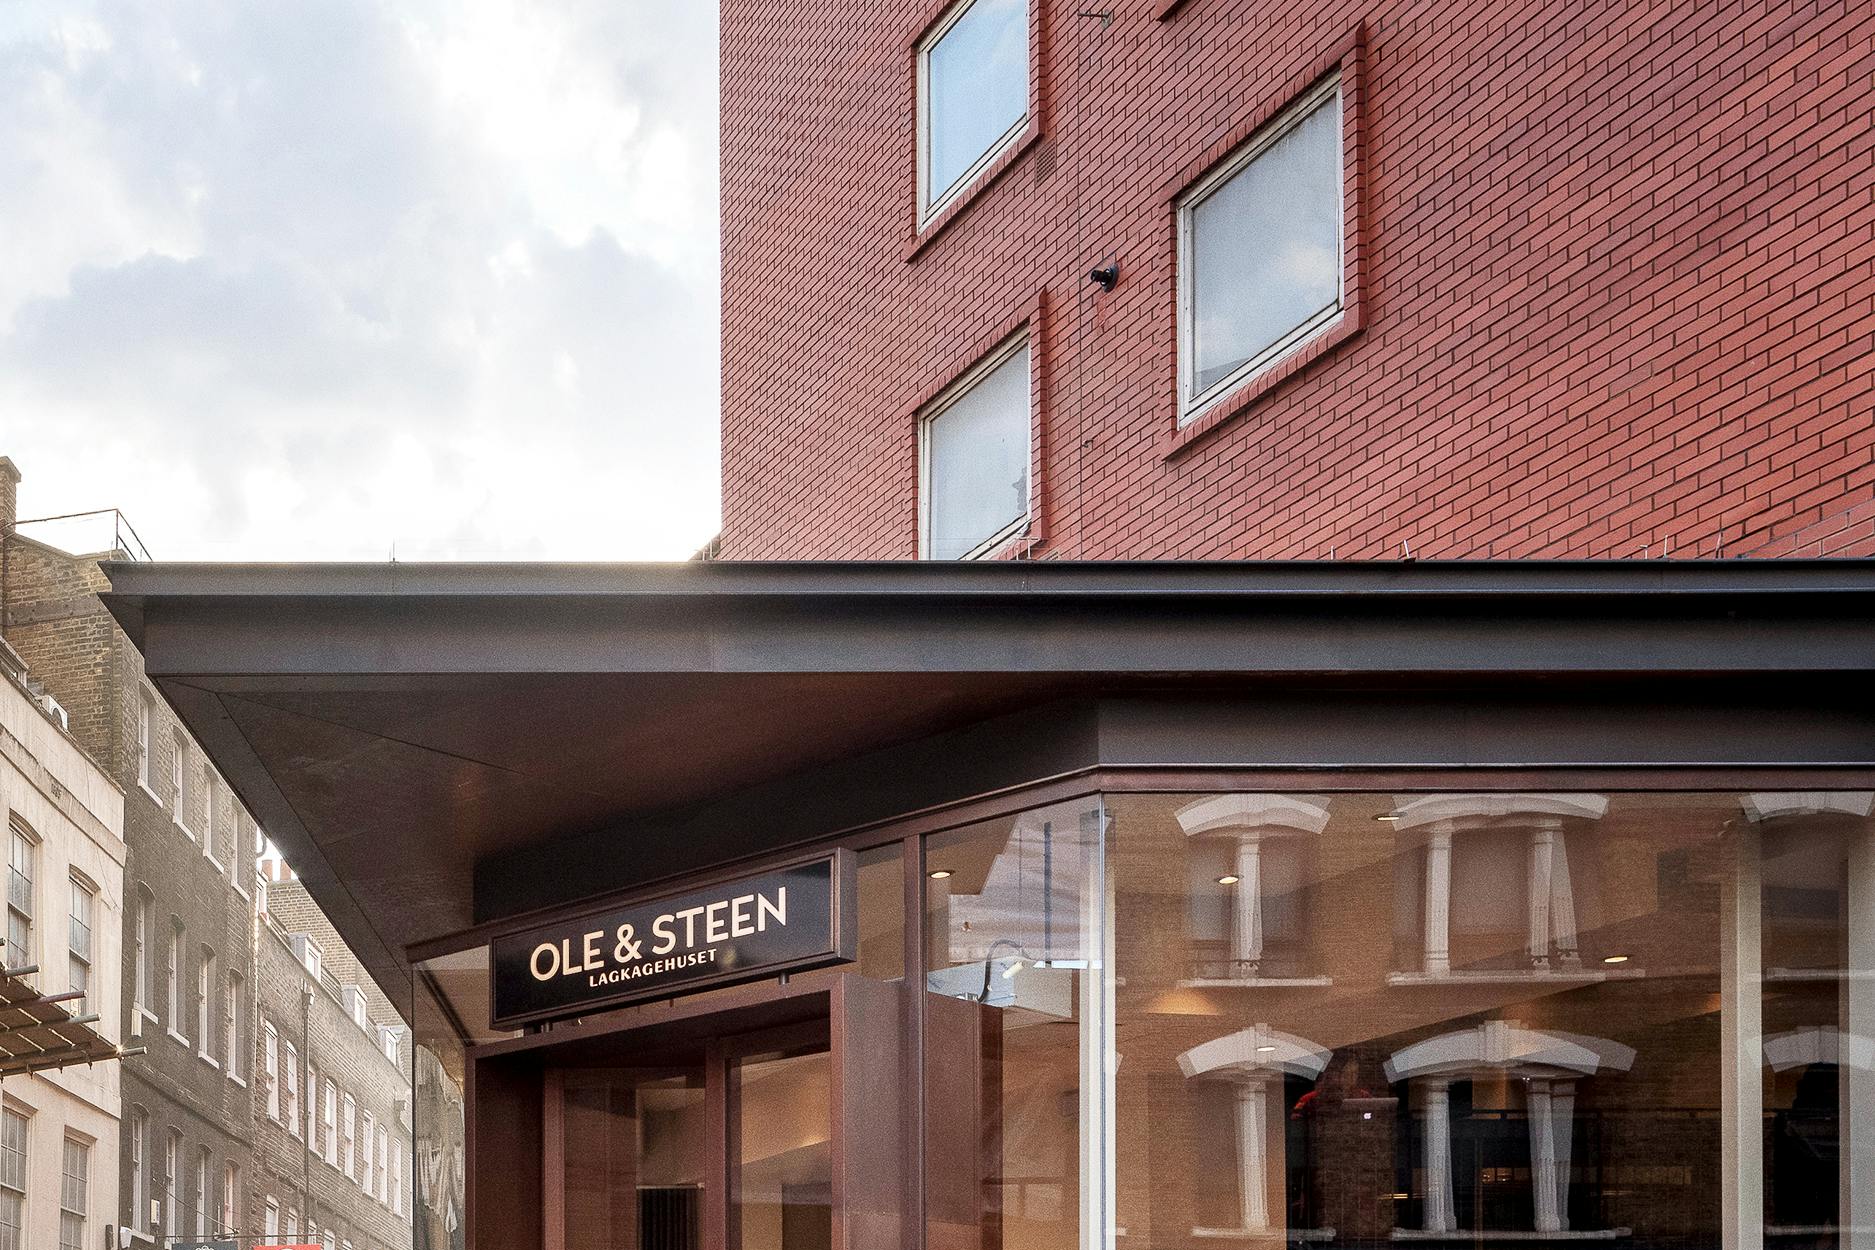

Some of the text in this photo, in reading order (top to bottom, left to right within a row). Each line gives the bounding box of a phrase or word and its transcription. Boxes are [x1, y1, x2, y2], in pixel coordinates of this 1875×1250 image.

[530, 886, 788, 982] OLE & STEEN
[589, 948, 718, 988] LAGKAGEHUSET
